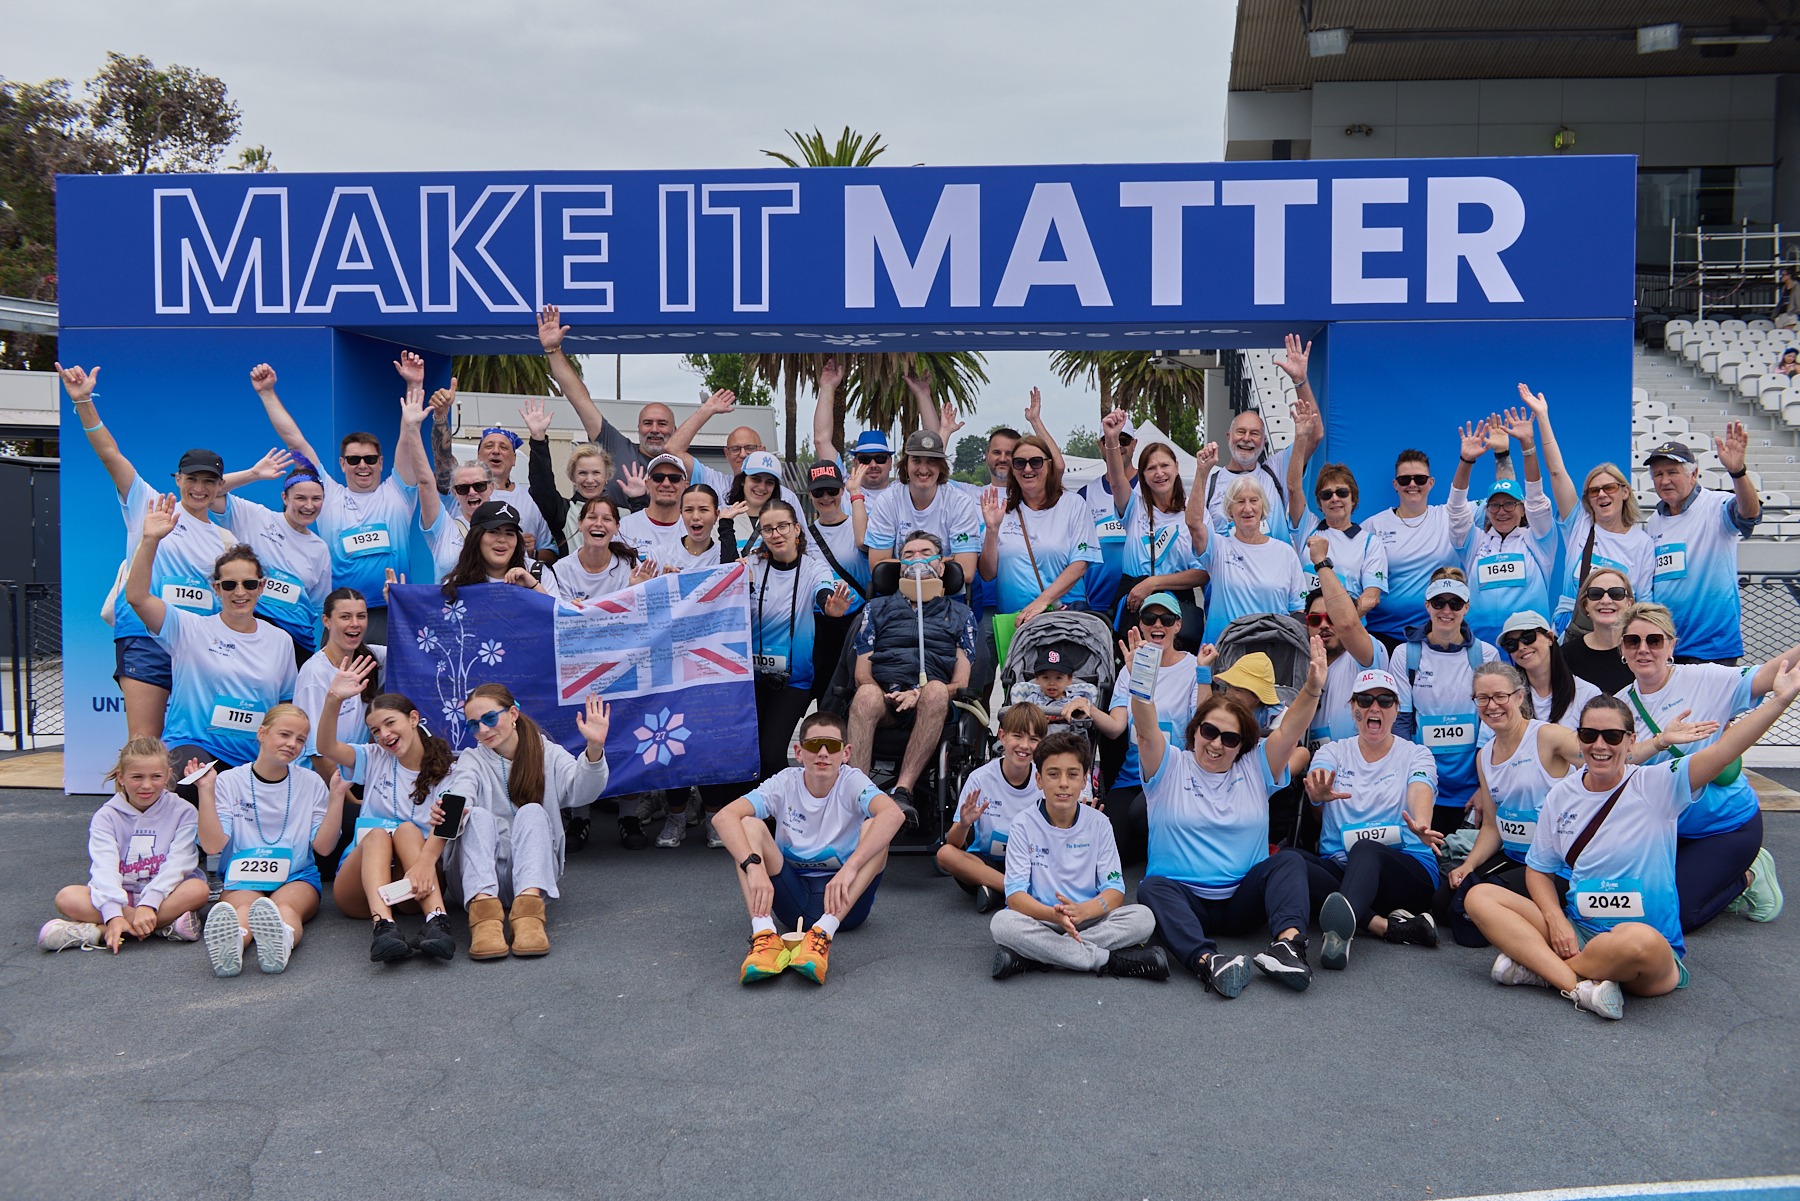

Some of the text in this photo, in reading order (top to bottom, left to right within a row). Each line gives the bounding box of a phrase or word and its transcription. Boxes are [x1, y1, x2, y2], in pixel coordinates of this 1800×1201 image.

[154, 176, 1527, 314] MAKE IT MATTER
[435, 333, 541, 341] Unti
[931, 329, 1110, 338] there's
[1124, 328, 1253, 336] care.
[1786, 456, 1795, 464] G
[810, 465, 837, 481] EVERLAST
[1104, 521, 1125, 531] 189
[352, 532, 380, 545] 1932
[1155, 530, 1169, 550] 1101
[1487, 563, 1515, 575] 1649
[265, 579, 290, 595] 926
[175, 587, 204, 601] 1140
[92, 696, 127, 713] UNT
[228, 710, 253, 724] 1115
[655, 732, 666, 741] 27
[1433, 727, 1464, 739] 2140
[1355, 828, 1388, 841] 1097
[1500, 820, 1527, 836] 1422
[240, 860, 279, 873] 2236
[1588, 895, 1632, 909] 2042
